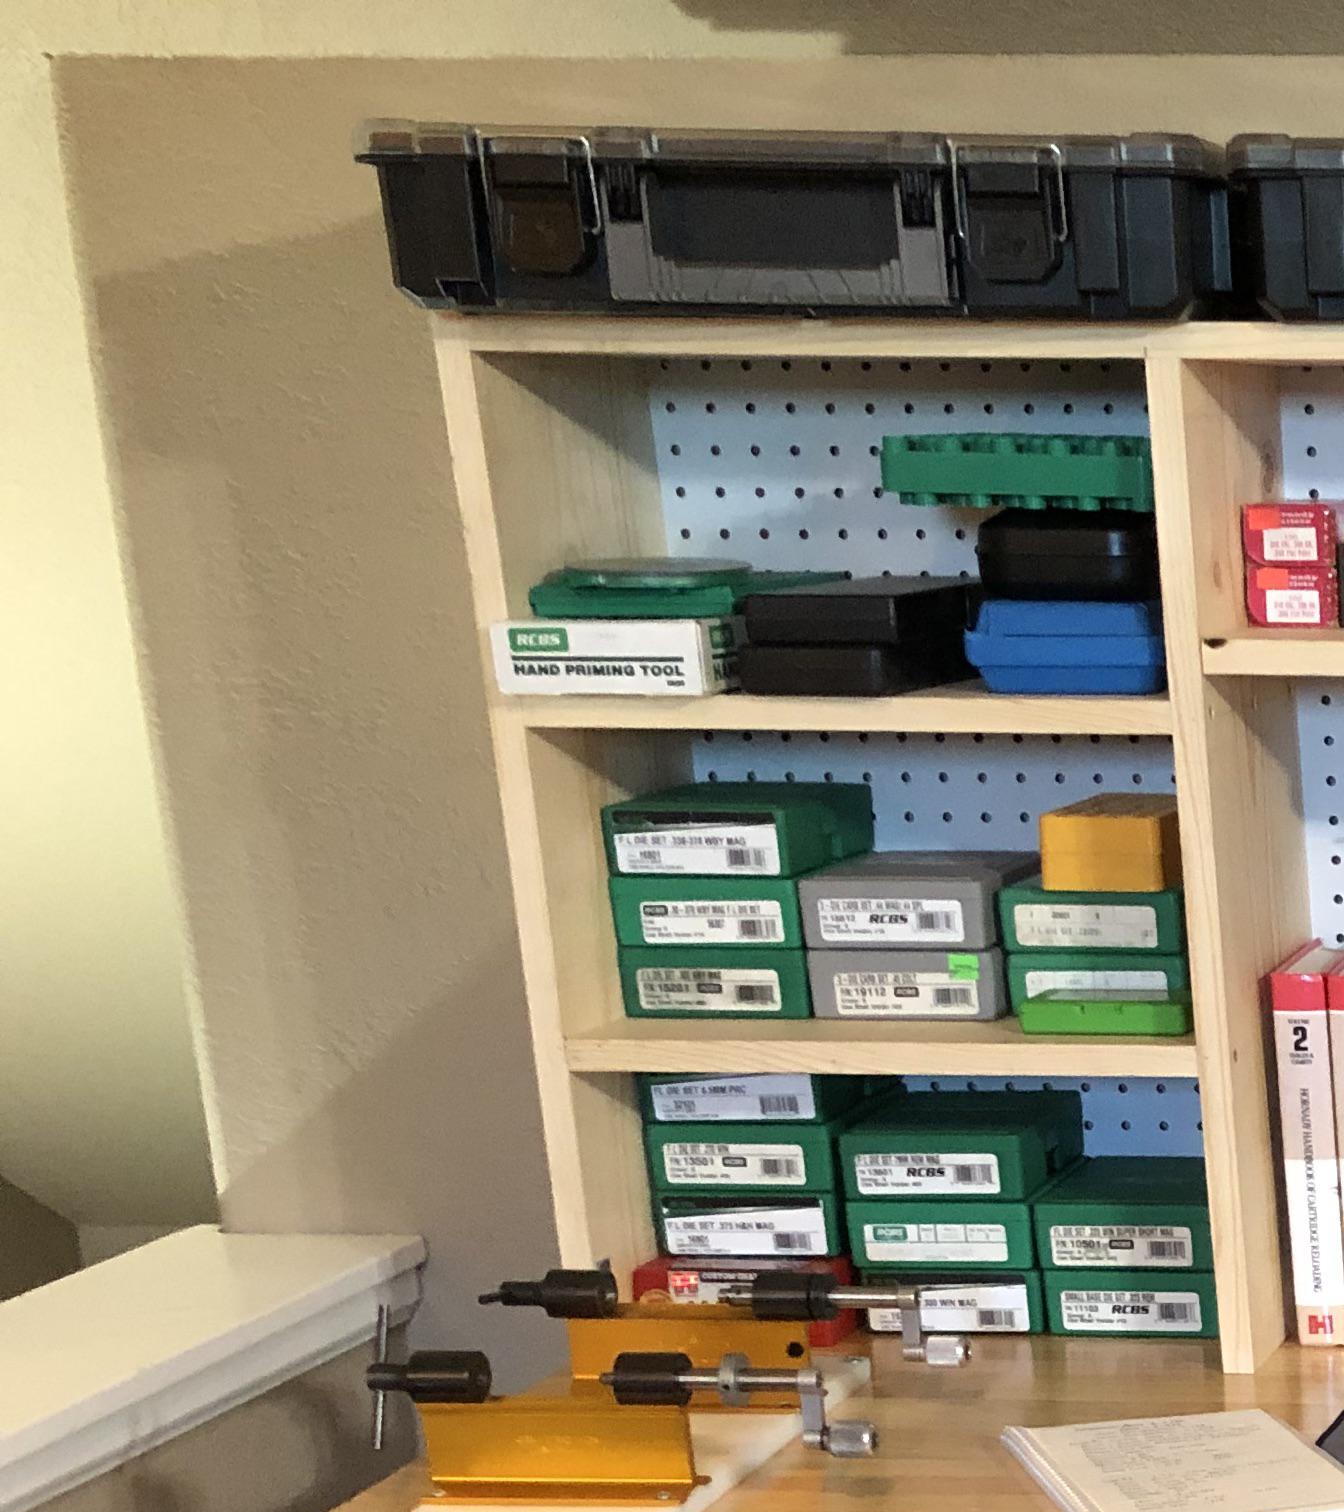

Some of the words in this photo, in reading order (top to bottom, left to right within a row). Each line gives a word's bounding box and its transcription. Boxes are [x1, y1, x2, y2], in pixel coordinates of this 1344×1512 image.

[516, 633, 561, 647] RCBS
[513, 664, 560, 676] HAND
[565, 665, 636, 677] PRIMING
[640, 665, 685, 677] TOOL
[869, 914, 909, 924] RCBS
[1292, 1026, 1309, 1052] 2
[906, 1167, 946, 1177] RCBS
[1112, 1304, 1149, 1314] RCBS
